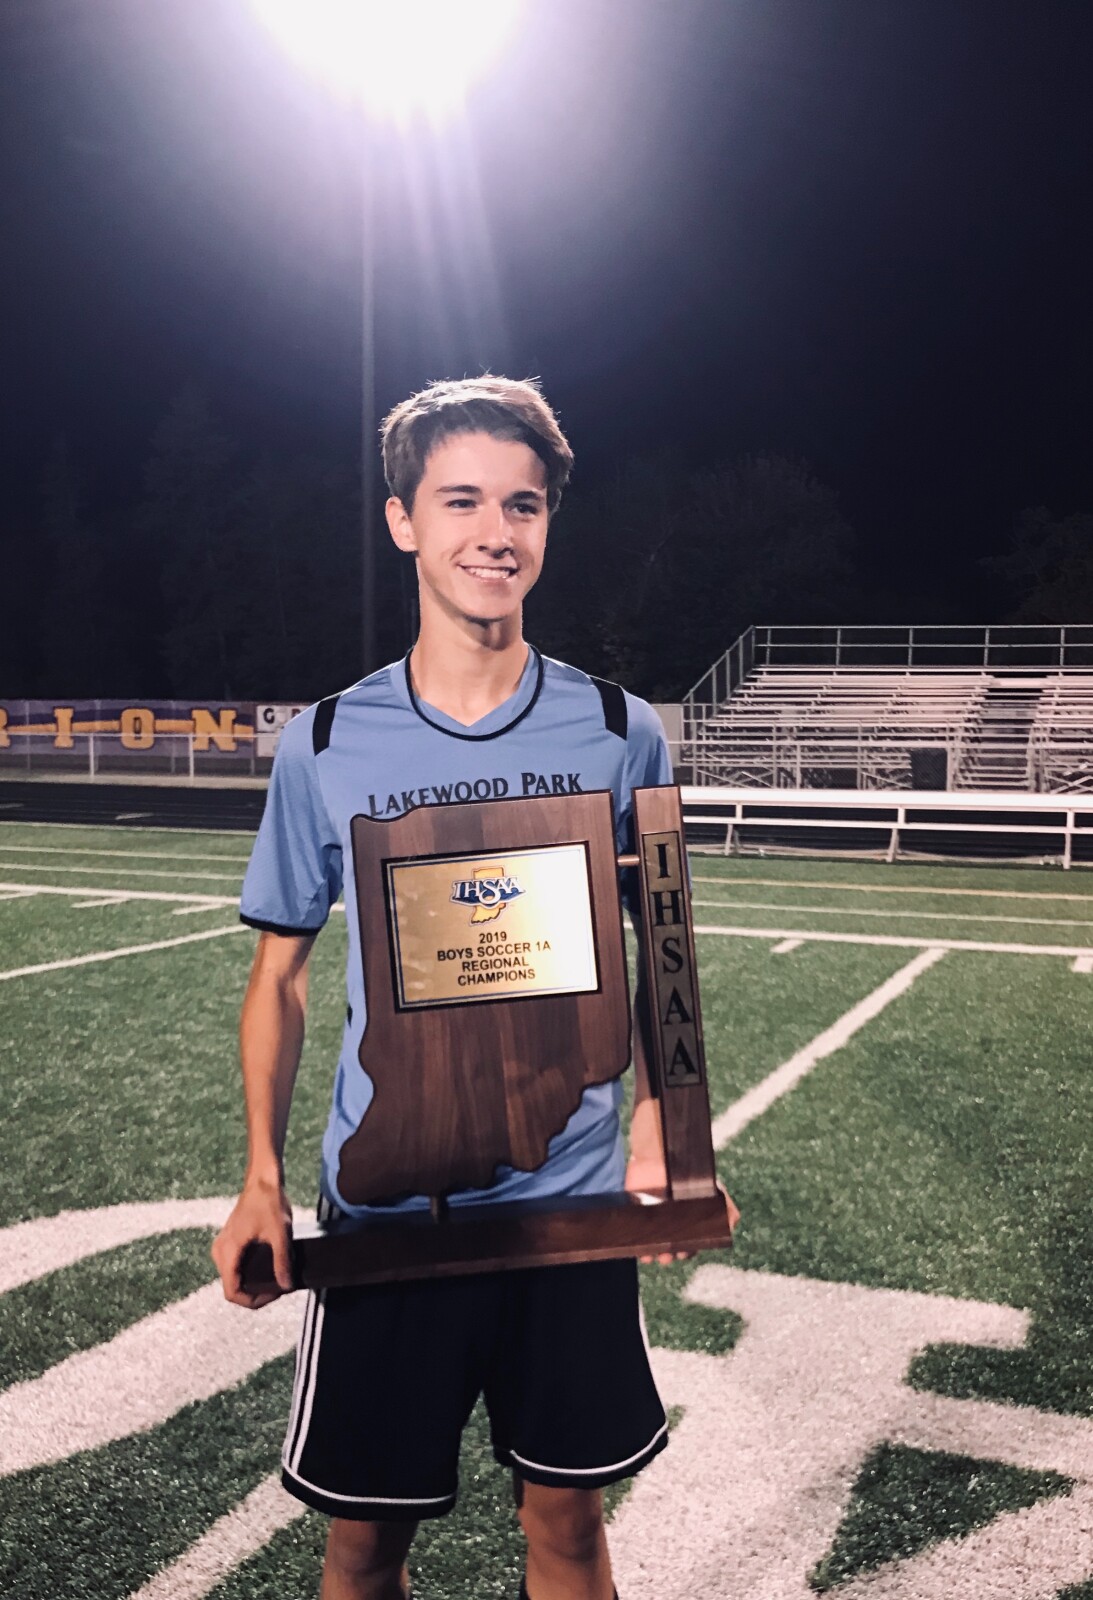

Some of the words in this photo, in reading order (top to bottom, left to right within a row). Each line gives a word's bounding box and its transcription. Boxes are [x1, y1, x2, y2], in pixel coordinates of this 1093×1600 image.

[0, 707, 237, 751] ION
[368, 777, 508, 816] LAKEWOOD
[521, 772, 583, 796] PARK
[453, 876, 525, 905] IHSAA
[479, 931, 507, 944] 2019
[437, 947, 473, 961] BOYS
[477, 943, 531, 957] SOCCER
[537, 940, 551, 951] 1A
[651, 842, 697, 1077] IHSAA
[461, 956, 529, 972] REGIONAL
[457, 968, 536, 986] CHAMPIONS
